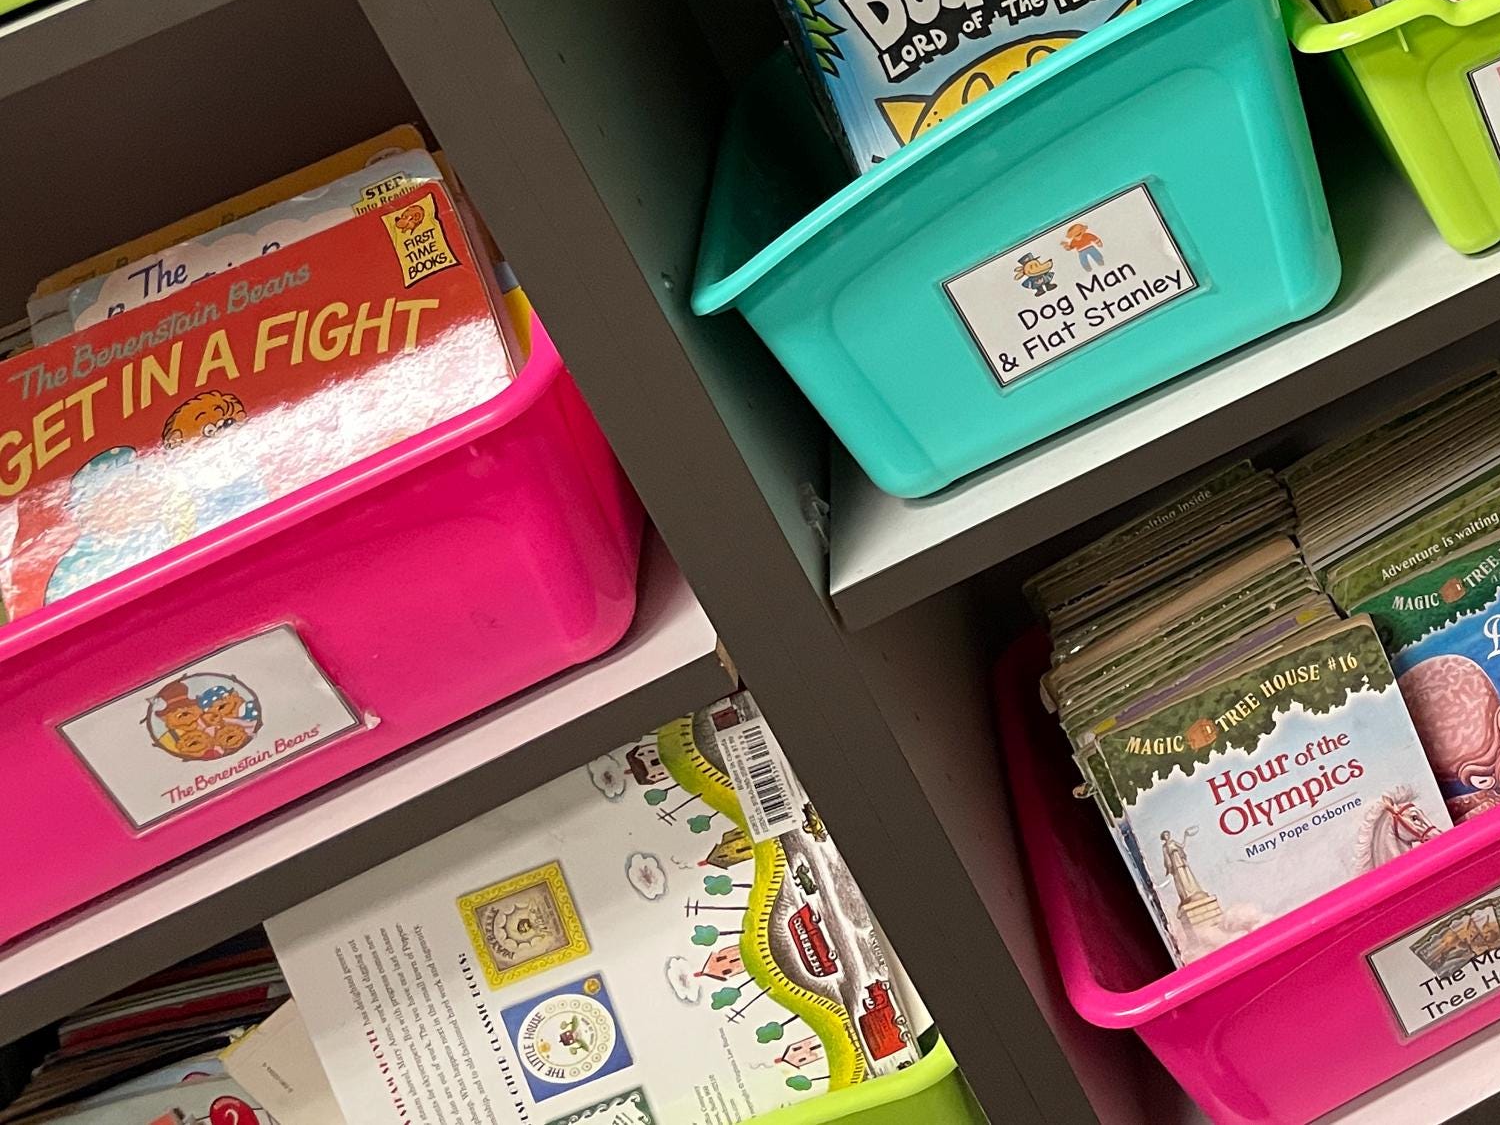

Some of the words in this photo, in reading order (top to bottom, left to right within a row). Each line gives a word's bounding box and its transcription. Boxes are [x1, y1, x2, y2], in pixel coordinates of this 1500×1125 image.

[881, 29, 949, 80] LORD
[961, 9, 985, 35] OF
[403, 228, 436, 251] FIRST
[405, 241, 439, 263] TIME
[128, 259, 188, 299] The
[408, 252, 448, 280] BOOKS
[998, 352, 1020, 373] &
[1022, 320, 1076, 360] Flat
[1084, 269, 1183, 327] Stanley
[1017, 295, 1075, 330] Dog
[1075, 262, 1137, 301] Man
[12, 367, 69, 402] The
[72, 295, 221, 381] Berenstain
[226, 263, 312, 315] Bears
[0, 376, 108, 499] GET
[122, 341, 183, 420] IN
[194, 329, 244, 388] A
[253, 298, 440, 373] FIGHT
[1381, 541, 1440, 581] Adventure
[1442, 534, 1454, 549] is
[1455, 512, 1500, 545] waiting
[1392, 591, 1441, 612] MAGIC
[1464, 555, 1499, 589] TREE
[1125, 735, 1185, 756] MAGIC
[1215, 693, 1261, 734] TREE
[1260, 664, 1321, 700] HOUSE
[1327, 652, 1358, 673] #16
[160, 784, 196, 805] The
[194, 749, 273, 791] Berenstain
[274, 724, 320, 755] Bears
[1206, 752, 1289, 806] Hour
[1294, 743, 1317, 767] of
[1317, 732, 1351, 756] the
[1218, 758, 1365, 836] Olympics
[1245, 836, 1278, 859] Mary
[1279, 823, 1310, 845] Pope
[1311, 795, 1362, 828] Osborne
[353, 953, 372, 984] digging
[380, 974, 400, 1007] progress
[1419, 969, 1465, 996] The
[475, 1000, 503, 1052] CLASSIC
[523, 1011, 547, 1041] HOUSE
[1421, 986, 1477, 1019] Tree
[443, 1044, 463, 1078] happens
[523, 1043, 546, 1073] LITTLE
[545, 1067, 567, 1080] THE
